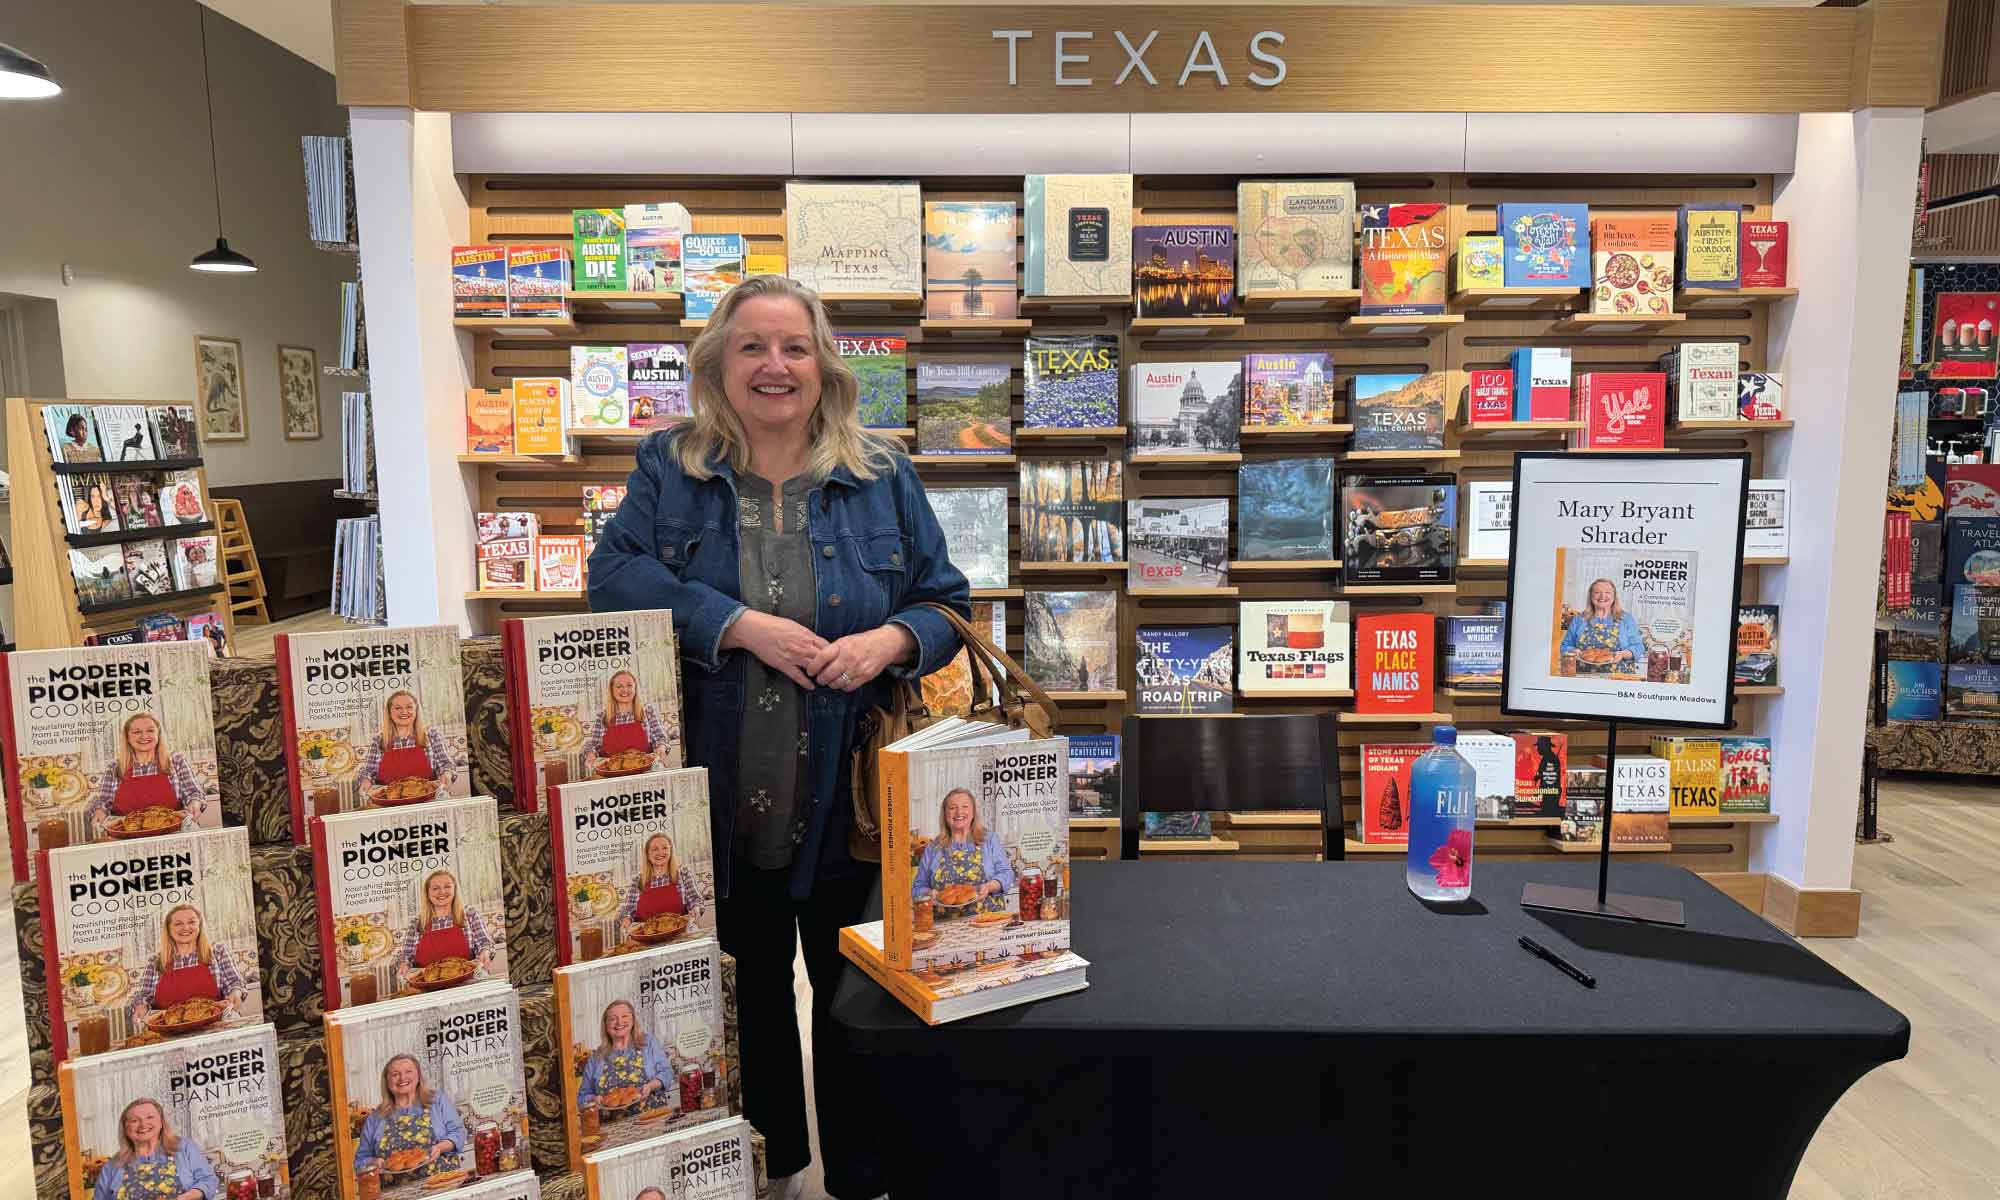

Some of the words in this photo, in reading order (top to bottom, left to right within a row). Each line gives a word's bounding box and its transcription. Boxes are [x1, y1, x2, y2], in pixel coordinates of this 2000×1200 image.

[991, 30, 1288, 87] TEXAS
[1530, 221, 1560, 237] TEXAS
[1603, 223, 1616, 231] The
[1750, 225, 1778, 235] TEXAS
[685, 236, 700, 249] 60
[701, 237, 726, 246] HIKES
[1164, 229, 1228, 246] AUSTIN
[1363, 225, 1446, 249] TEXAS
[582, 243, 621, 255] AUSTIN
[699, 247, 714, 257] 60
[714, 245, 739, 254] MILES
[821, 245, 889, 259] MAPPING
[1368, 251, 1375, 261] A
[1418, 251, 1440, 261] Atlas
[1693, 246, 1732, 254] COOKBOOK
[454, 252, 496, 265] AUSTIN
[511, 252, 552, 265] AUSTIN
[585, 261, 616, 278] DIE
[831, 260, 879, 274] TEXAS
[1034, 349, 1111, 370] TEXAS
[1257, 358, 1296, 370] Austin
[588, 375, 612, 384] AUSTIN
[632, 369, 679, 381] AUSTIN
[920, 366, 934, 377] The
[936, 367, 956, 377] Texas
[957, 366, 971, 377] Hill
[971, 367, 1000, 378] Country
[1146, 372, 1182, 384] Austin
[1479, 374, 1505, 386] 100
[1689, 367, 1733, 380] Texan
[1532, 377, 1568, 386] Texas
[478, 399, 509, 408] AUSTIN
[1476, 400, 1507, 411] TEXAS
[1752, 404, 1777, 417] Texan
[1371, 412, 1427, 425] TEXAS
[1557, 500, 1615, 521] Mary
[1620, 500, 1696, 523] Bryant
[1749, 501, 1767, 509] BOOK
[1758, 518, 1777, 526] FOUR
[1580, 526, 1668, 546] Shrader
[1974, 540, 2000, 548] ATLA
[481, 540, 528, 558] TEXAS
[1136, 562, 1183, 577] Texas
[1635, 560, 1688, 570] MODERN
[1623, 569, 1688, 581] PIONEER
[1622, 579, 1687, 593] PANTRY
[554, 627, 630, 644] MODERN
[1462, 625, 1499, 634] LAWRENCE
[1467, 633, 1494, 641] WRIGHT
[1738, 630, 1765, 640] AUSTIN
[1143, 642, 1170, 653] THE
[1375, 630, 1417, 649] TEXAS
[324, 644, 409, 662] MODERN
[539, 641, 632, 662] PIONEER
[1247, 651, 1295, 662] Texas
[1298, 650, 1344, 664] Flags
[539, 657, 632, 676] COOKBOOK
[1143, 658, 1231, 670] FIFTY-YEAR
[1376, 651, 1416, 670] PLACE
[27, 674, 46, 684] the
[49, 662, 150, 681] MODERN
[306, 659, 412, 682] PIONEER
[1965, 673, 1998, 681] HOTELS
[307, 677, 413, 696] COOKBOOK
[1143, 674, 1190, 686] TEXAS
[1372, 672, 1420, 691] NAMES
[28, 679, 153, 704] PIONEER
[1143, 691, 1182, 702] ROAD
[1190, 691, 1223, 702] TRIP
[1617, 690, 1635, 699] B&N
[1637, 691, 1677, 702] Southpark
[1679, 695, 1717, 704] Meadows
[1900, 687, 1937, 695] BEACHES
[30, 697, 153, 719] COOKBOOK
[996, 753, 1057, 768] MODERN
[1674, 759, 1717, 772] TALES
[1721, 748, 1771, 768] FORGET
[982, 767, 1057, 785] PIONEER
[1617, 766, 1666, 779] KINGS
[1730, 766, 1758, 785] THE
[983, 782, 1056, 800] PANTRY
[1514, 787, 1559, 795] Secessionists
[1514, 794, 1544, 803] Standoff
[1616, 785, 1666, 798] TEXAS
[1672, 786, 1717, 808] TEXAS
[591, 789, 665, 811] MODERN
[1435, 790, 1470, 815] FIJI
[576, 804, 667, 830] PIONEER
[341, 840, 358, 848] the
[360, 822, 448, 846] MODERN
[575, 820, 669, 843] COOKBOOK
[343, 837, 450, 868] PIONEER
[68, 872, 87, 881] the
[90, 852, 192, 879] MODERN
[343, 855, 450, 882] COOKBOOK
[70, 869, 194, 902] PIONEER
[71, 888, 195, 918] COOKBOOK
[652, 957, 710, 978] MODERN
[640, 968, 711, 994] PIONEER
[641, 982, 711, 1008] PANTRY
[440, 1007, 507, 1030] MODERN
[426, 1019, 508, 1048] PIONEER
[426, 1034, 509, 1064] PANTRY
[186, 1047, 263, 1072] MODERN
[171, 1061, 265, 1091] PIONEER
[173, 1076, 266, 1108] PANTRY
[682, 1138, 740, 1162] MODERN
[671, 1149, 742, 1179] PIONEER
[672, 1165, 742, 1194] PANTRY
